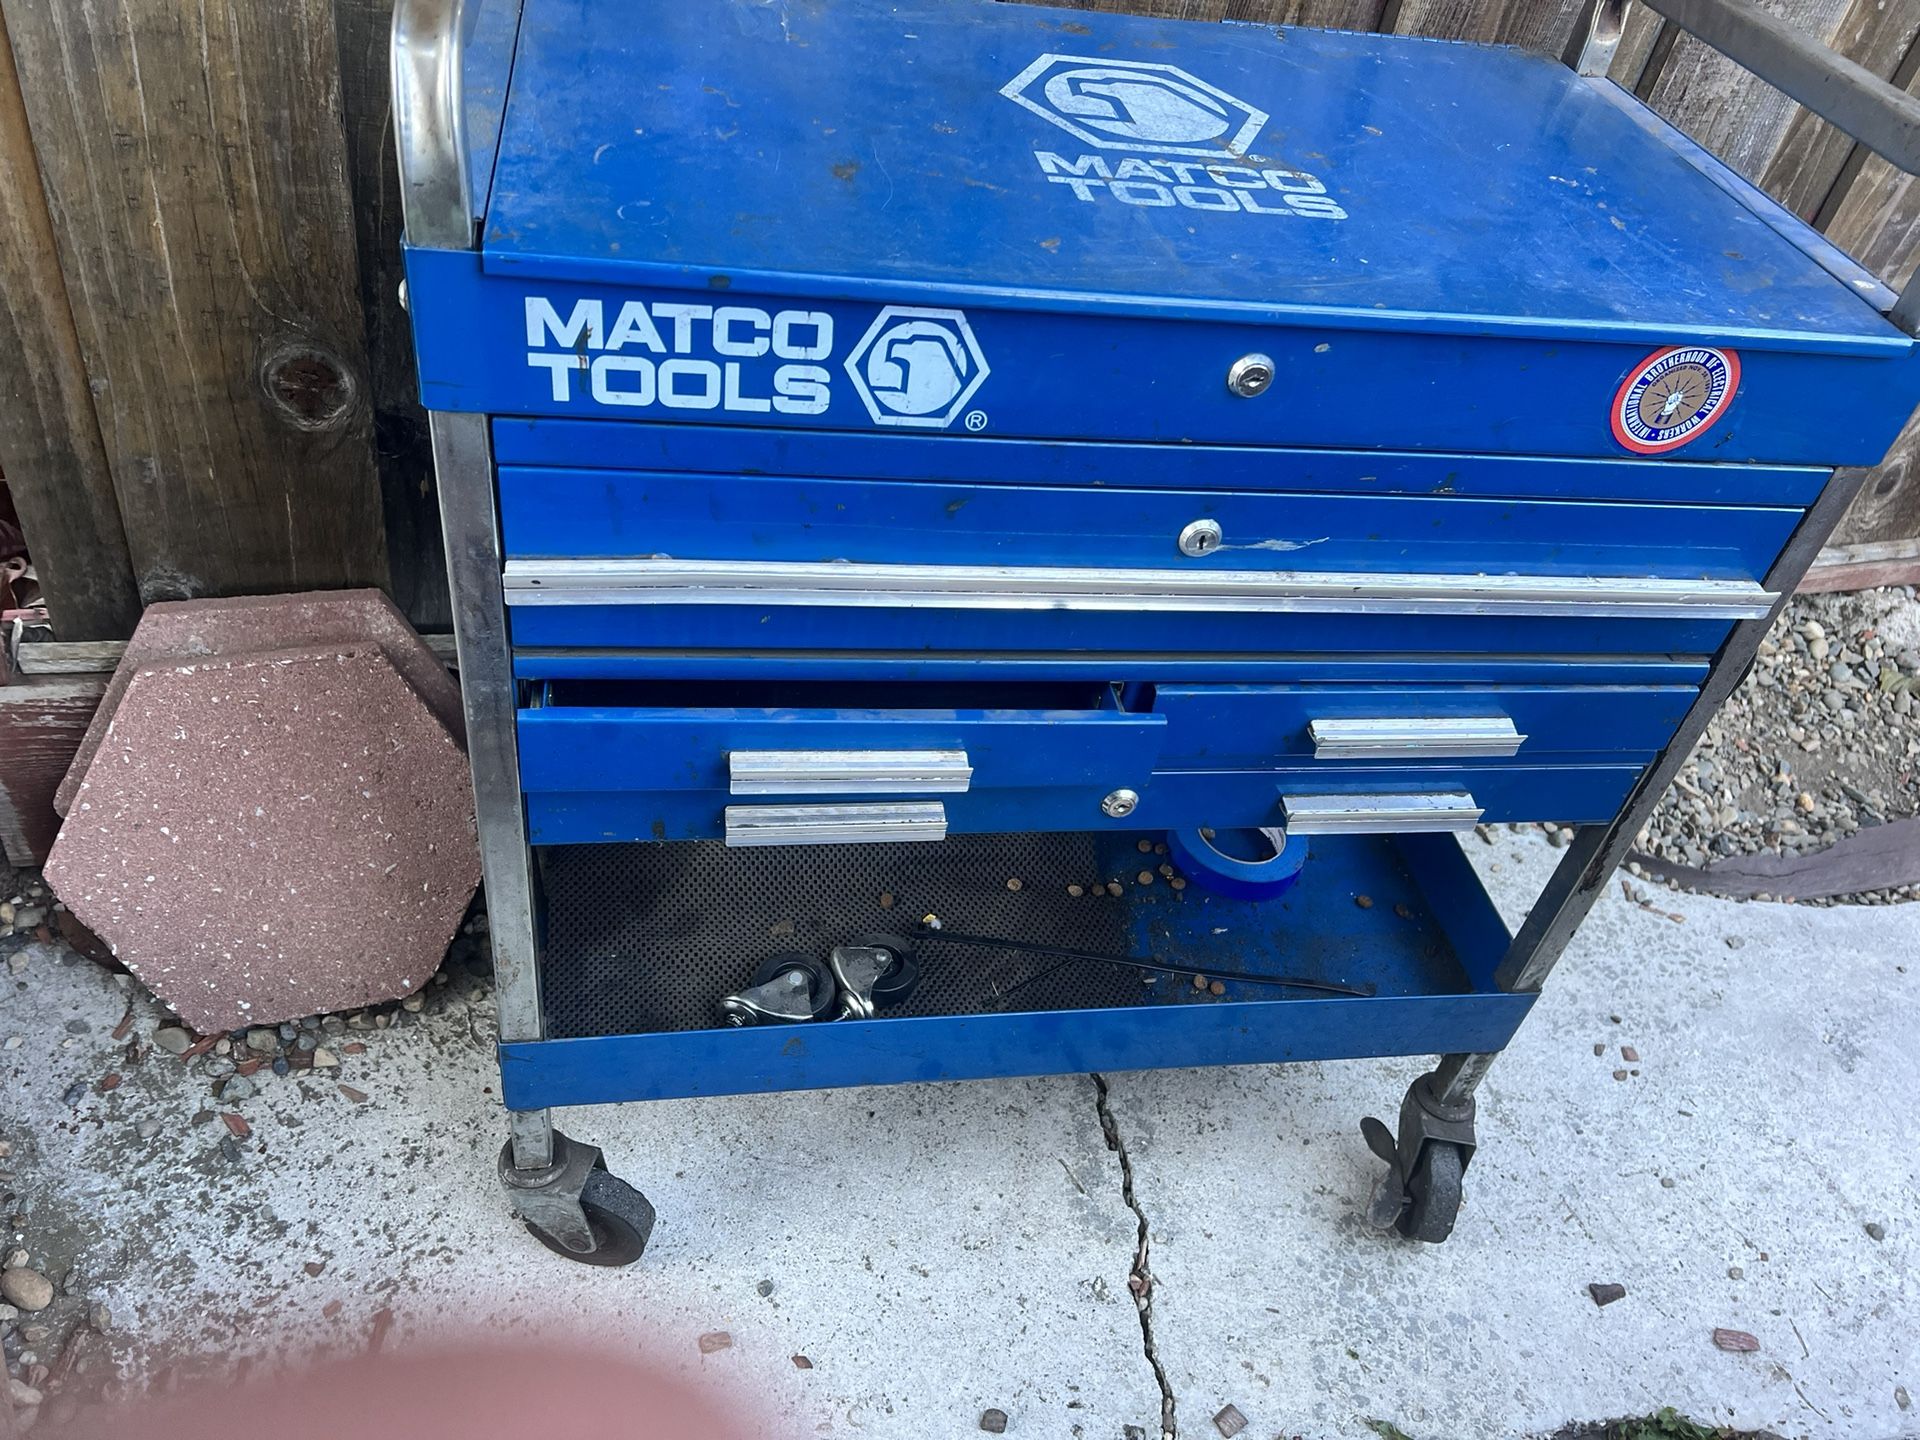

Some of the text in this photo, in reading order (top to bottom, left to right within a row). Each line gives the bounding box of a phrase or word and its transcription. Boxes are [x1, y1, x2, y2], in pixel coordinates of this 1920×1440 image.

[1034, 151, 1327, 194] MATCO
[1047, 176, 1349, 220] TOOLS
[525, 296, 833, 361] MATCO
[527, 352, 831, 415] TOOLS
[1645, 351, 1709, 382] BROTHERHOOD
[1706, 355, 1721, 370] OF
[1698, 367, 1726, 414] ELECTRICAL
[1657, 415, 1701, 440] WORKERS
